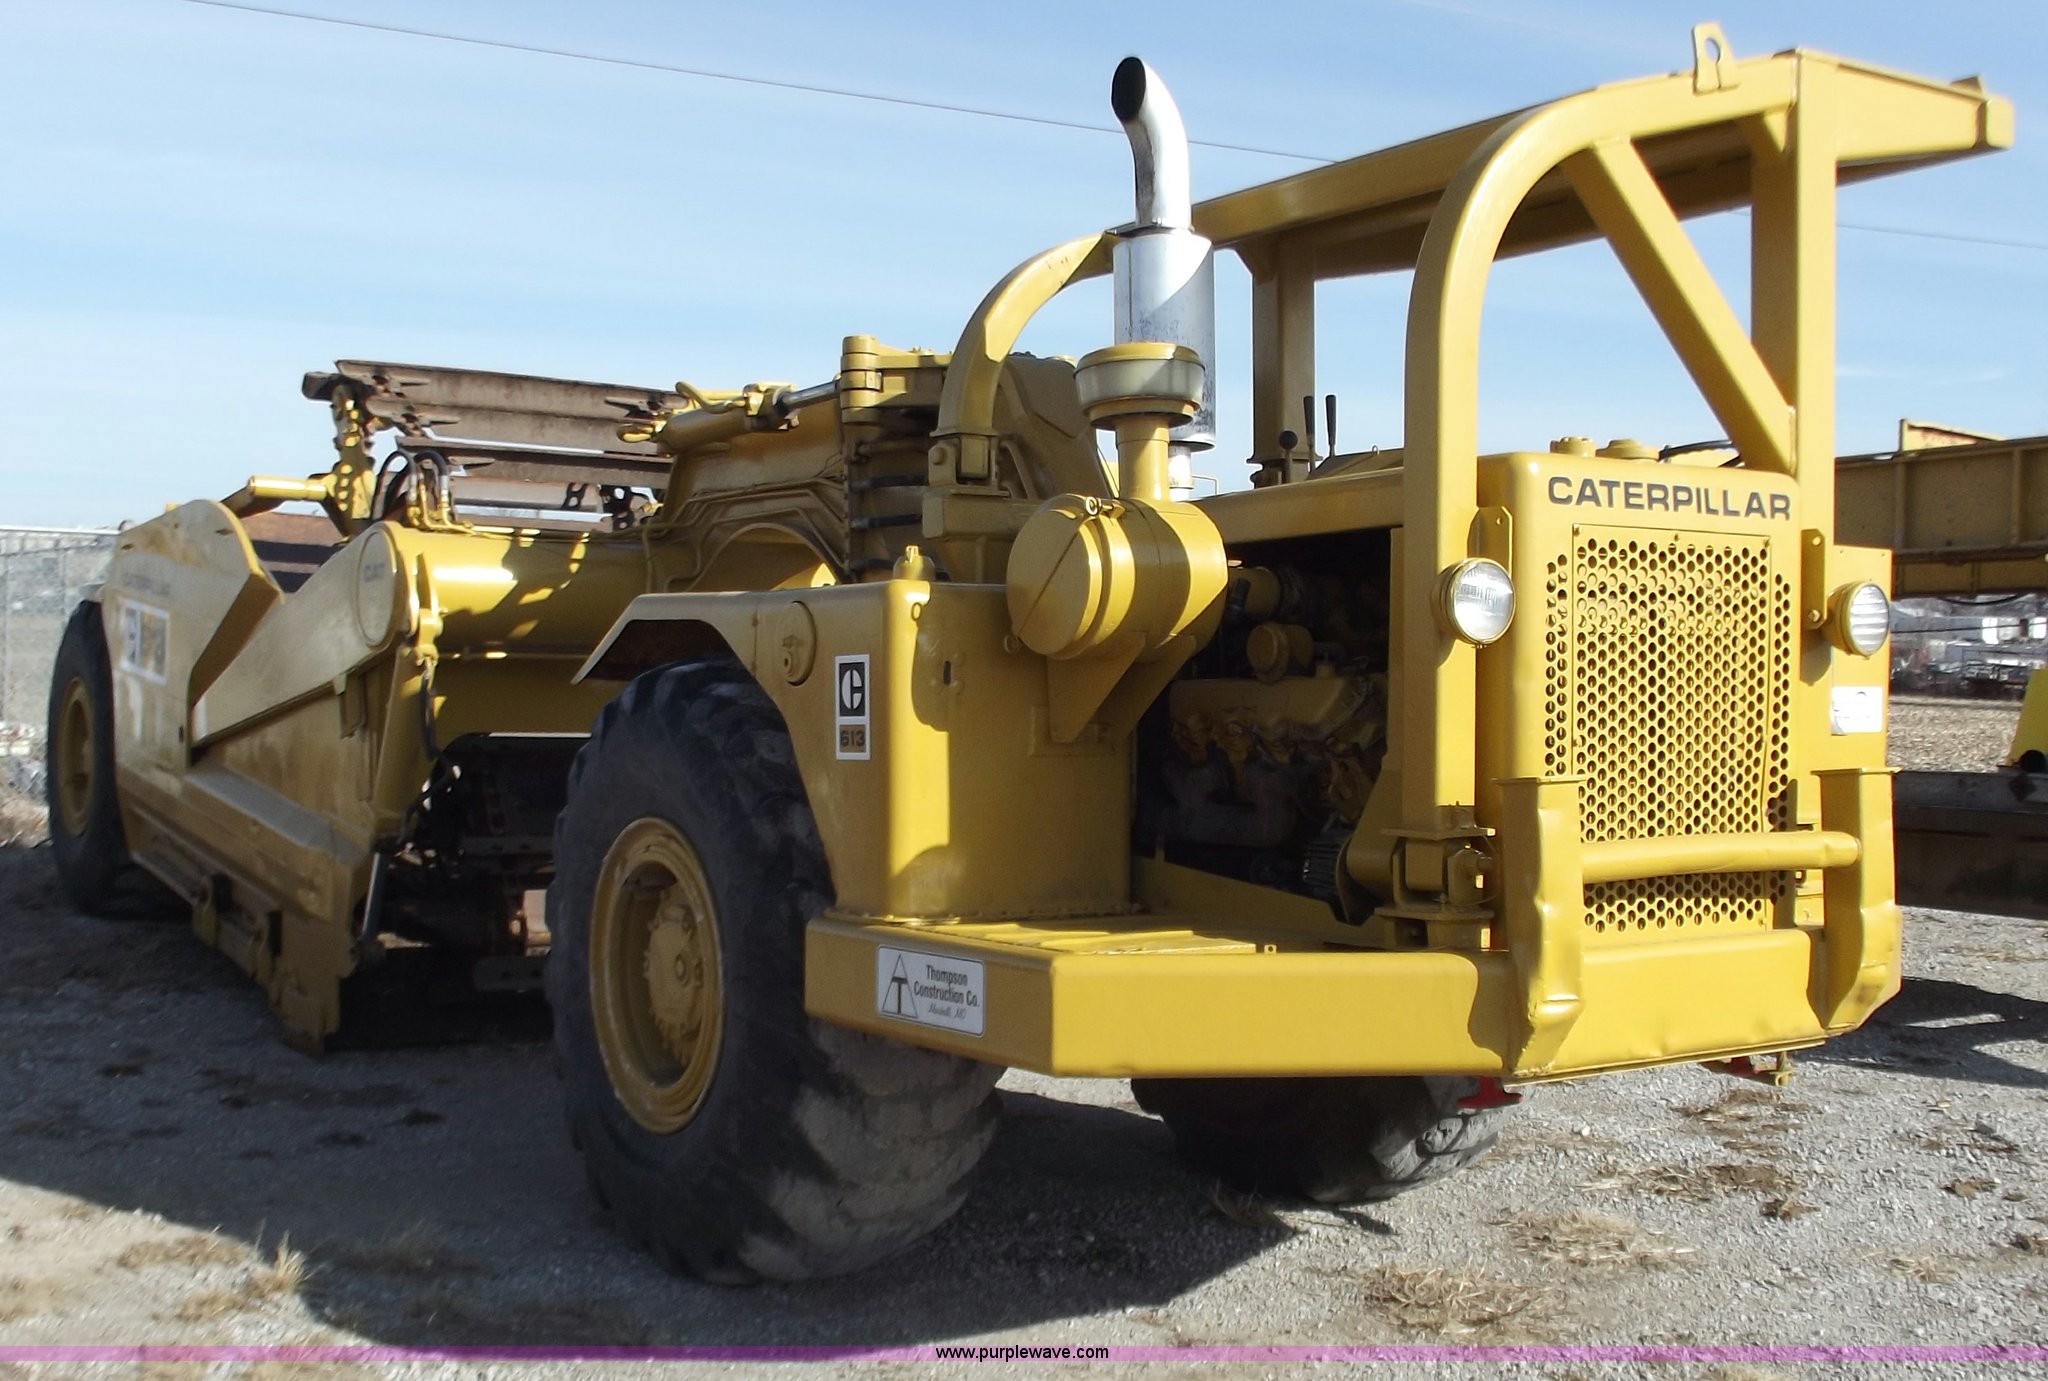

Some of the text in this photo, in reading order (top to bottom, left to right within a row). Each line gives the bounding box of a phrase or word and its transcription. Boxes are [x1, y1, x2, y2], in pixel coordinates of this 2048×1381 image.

[1548, 476, 1791, 521] CATERPILLAR
[841, 730, 865, 747] 613
[926, 964, 968, 987] Thompson
[914, 980, 980, 1008] Construction Co.
